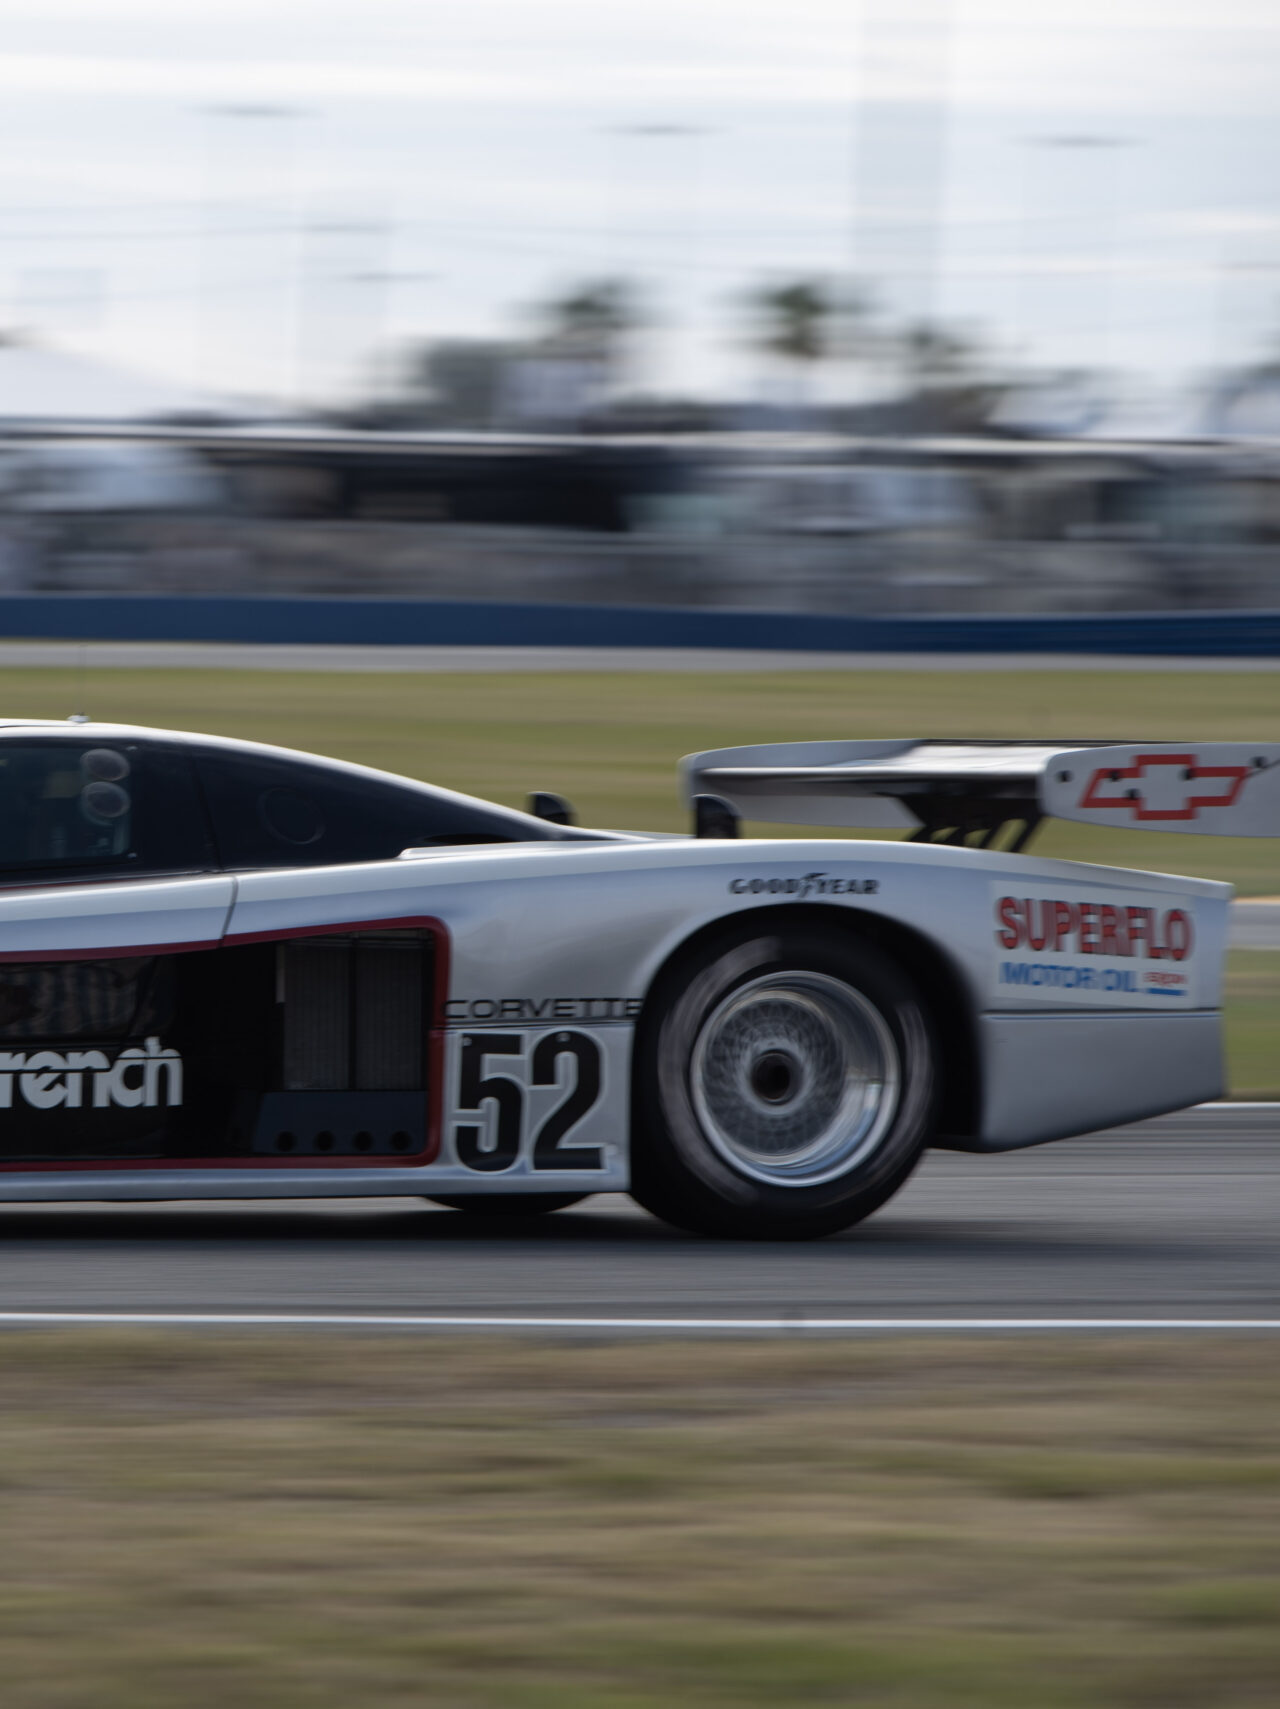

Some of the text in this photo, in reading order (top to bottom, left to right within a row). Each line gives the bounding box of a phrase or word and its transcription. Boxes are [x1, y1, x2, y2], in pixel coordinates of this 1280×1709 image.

[729, 872, 880, 898] GOODYEAR
[995, 897, 1194, 960] SUPERFLO
[1001, 962, 1095, 988] MOTOR
[1101, 968, 1138, 992] OIL
[445, 998, 642, 1019] CORVETTE
[456, 1030, 604, 1172] 52
